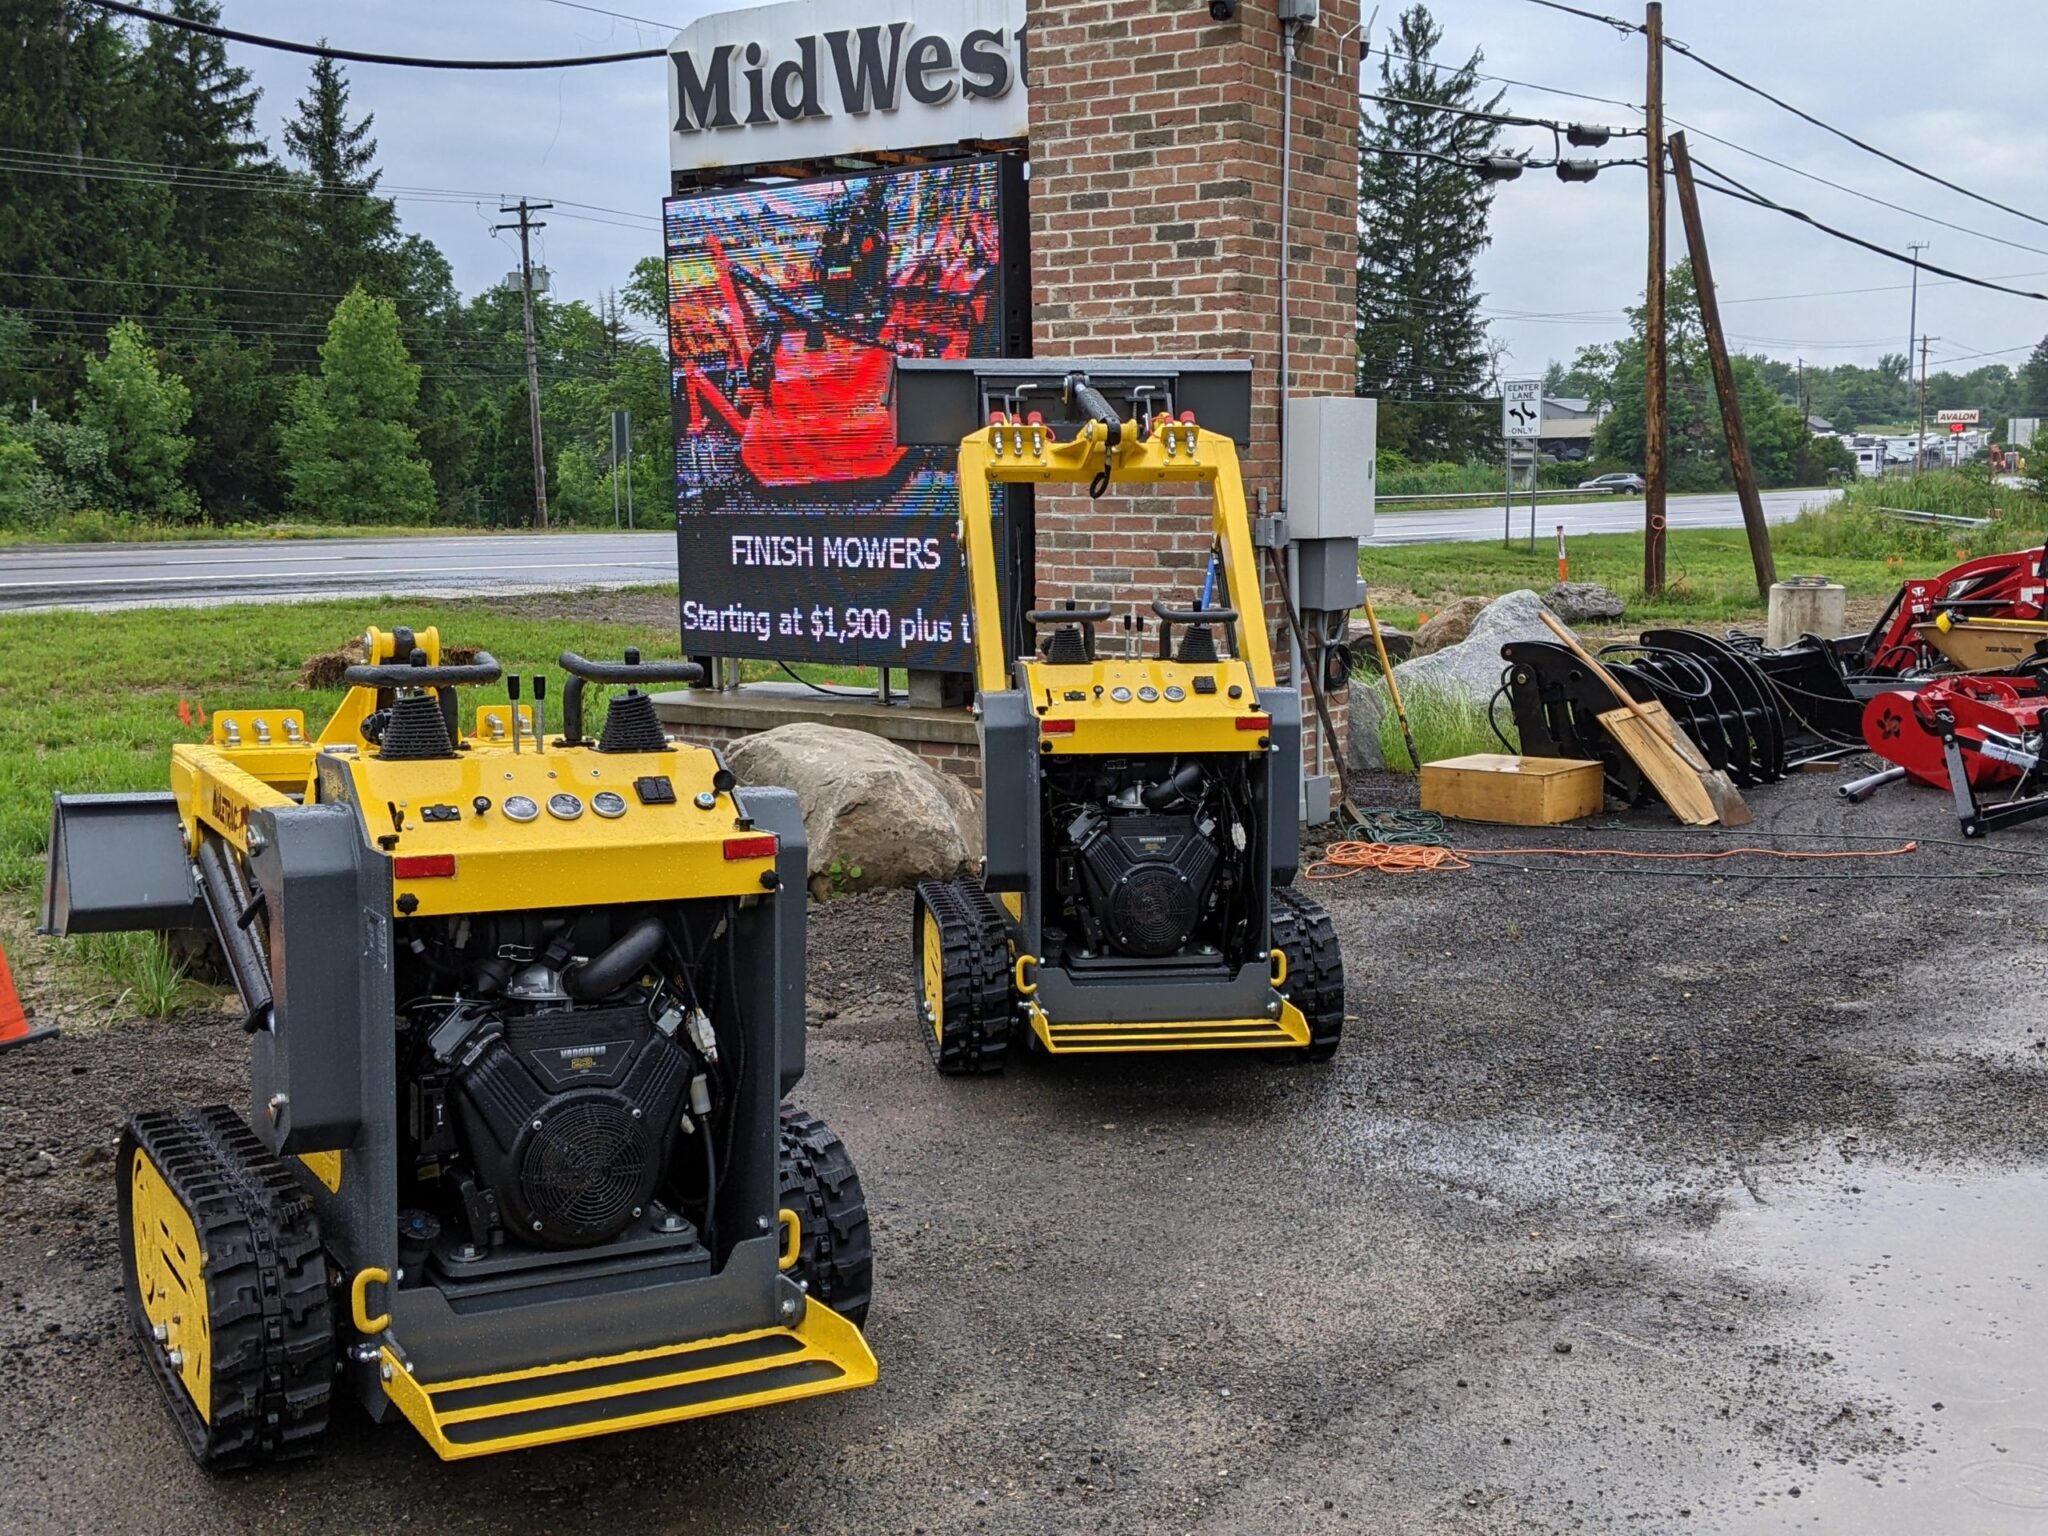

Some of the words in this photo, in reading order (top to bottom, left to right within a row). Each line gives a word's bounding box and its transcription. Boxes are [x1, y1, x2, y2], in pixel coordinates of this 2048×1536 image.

[1507, 384, 1539, 392] CENTER
[1512, 391, 1534, 399] LANE
[1940, 413, 1977, 421] AVALON
[1511, 427, 1534, 435] ONLY
[732, 535, 813, 567] FINISH
[823, 536, 941, 569] MOWERS
[683, 601, 770, 641] Starting
[779, 607, 803, 636] at
[810, 604, 890, 643] $1,900
[901, 608, 952, 648] plus
[560, 1046, 606, 1059] VANGUARD
